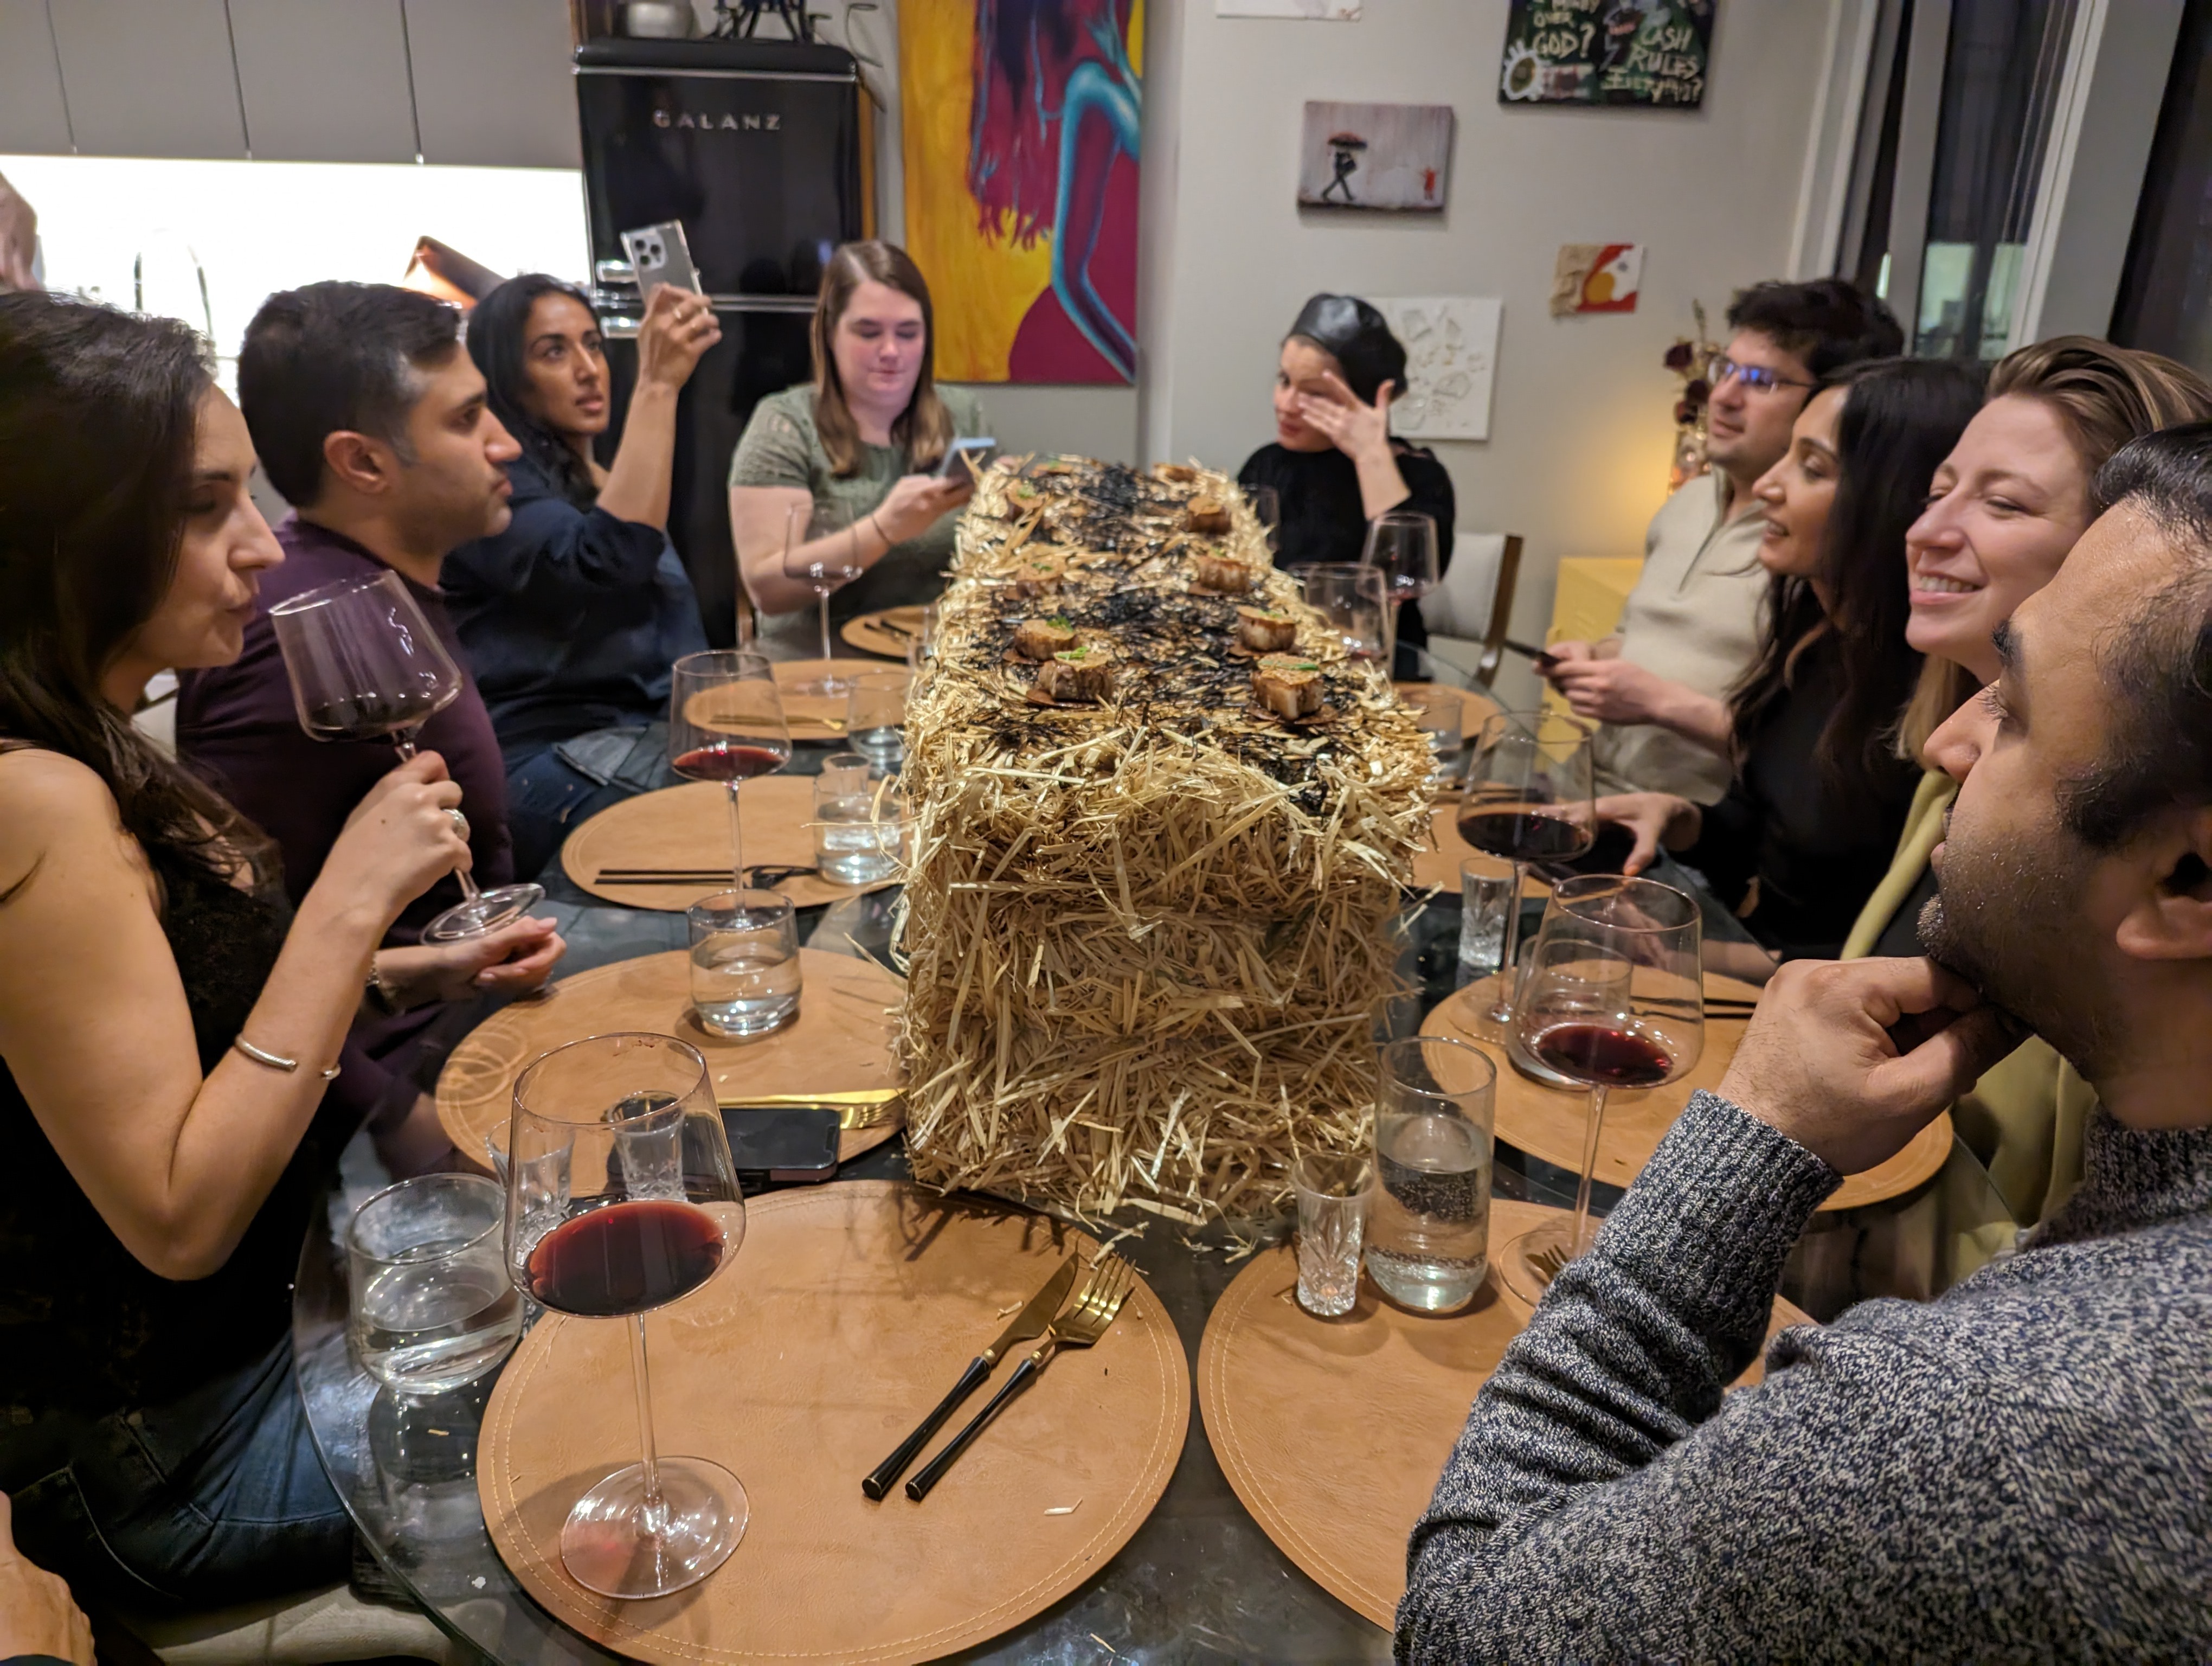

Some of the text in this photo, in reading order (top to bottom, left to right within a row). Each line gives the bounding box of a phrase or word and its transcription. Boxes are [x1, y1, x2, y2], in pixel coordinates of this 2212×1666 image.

[1533, 23, 1596, 59] GOD?
[1639, 26, 1693, 52] CASH
[1627, 44, 1699, 79] RULES
[652, 110, 781, 131] GALANZ
